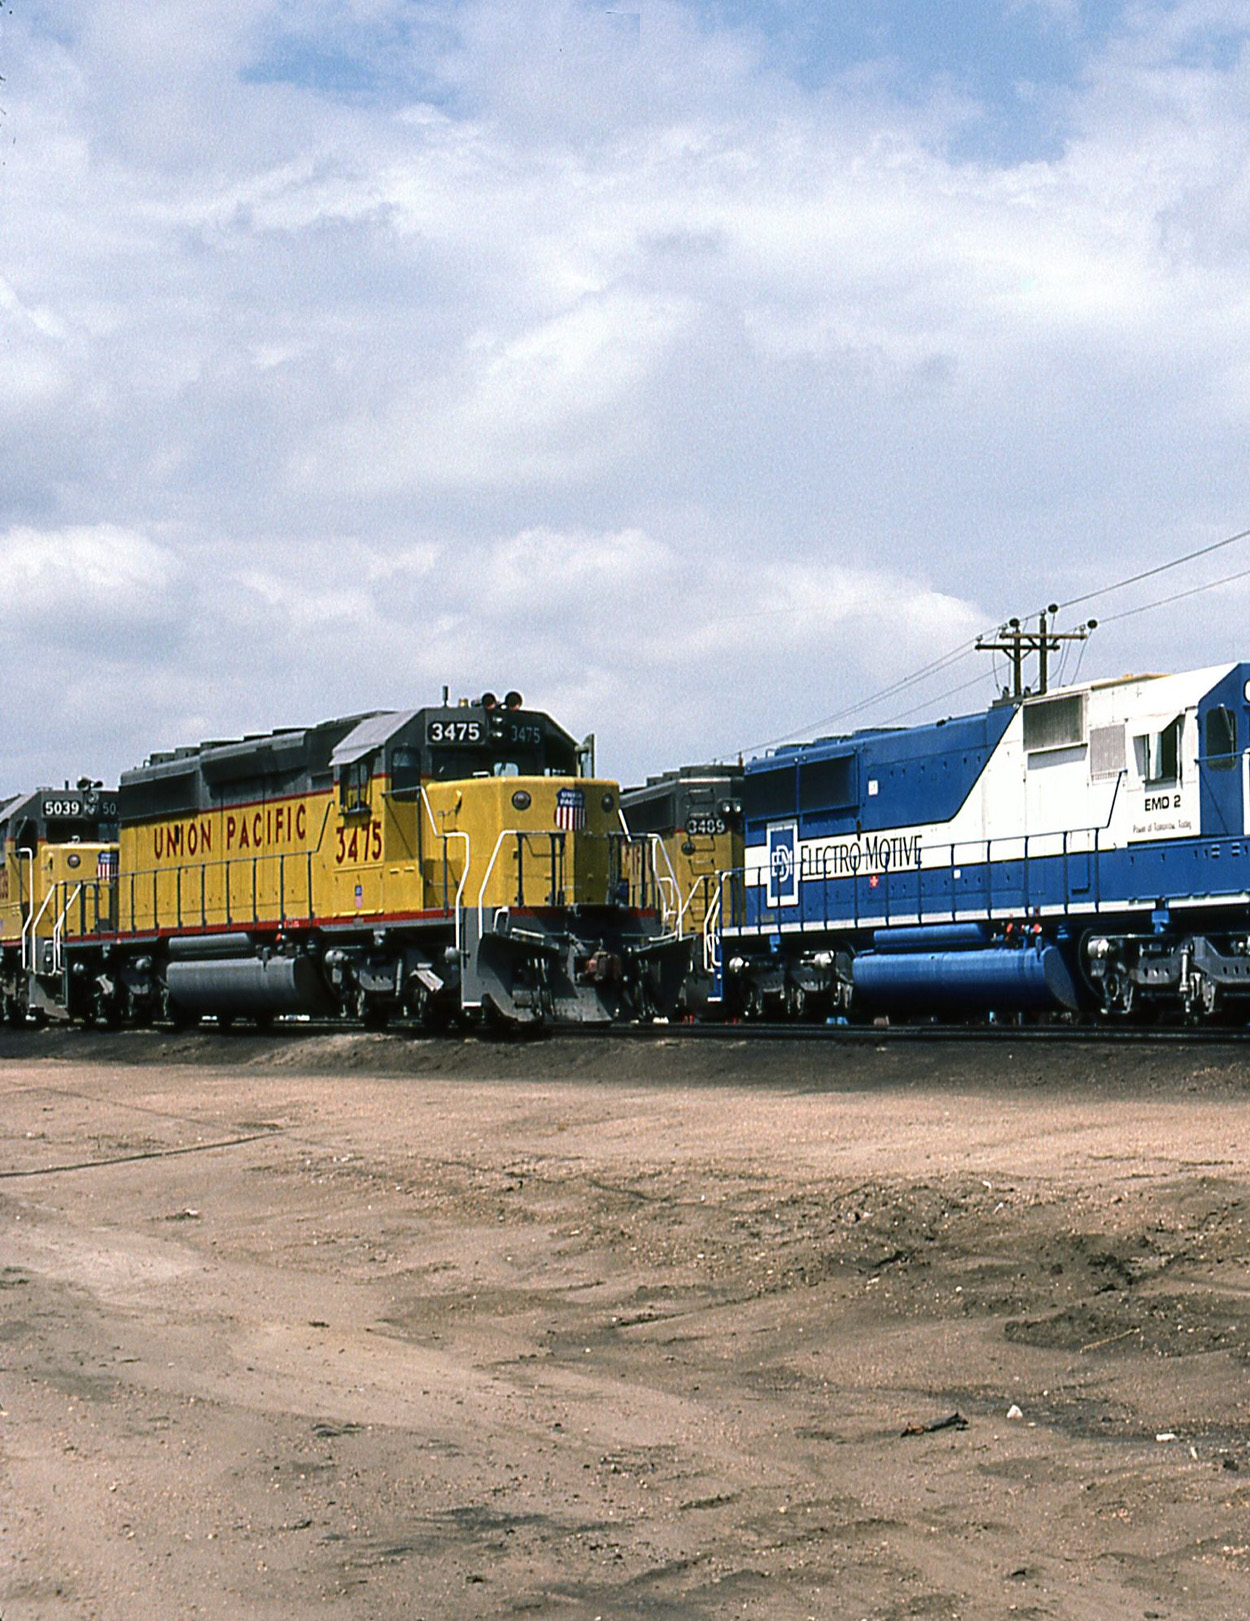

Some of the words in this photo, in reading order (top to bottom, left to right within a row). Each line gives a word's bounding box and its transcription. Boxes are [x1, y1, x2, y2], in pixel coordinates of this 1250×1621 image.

[431, 722, 480, 741] 3475
[511, 725, 541, 744] 3475
[44, 801, 80, 816] 5039
[102, 803, 120, 816] 50
[1145, 796, 1170, 811] EMD
[1174, 794, 1181, 808] 2
[154, 819, 212, 860] UNION
[227, 803, 306, 850] PACIFIC
[336, 821, 383, 864] 3475
